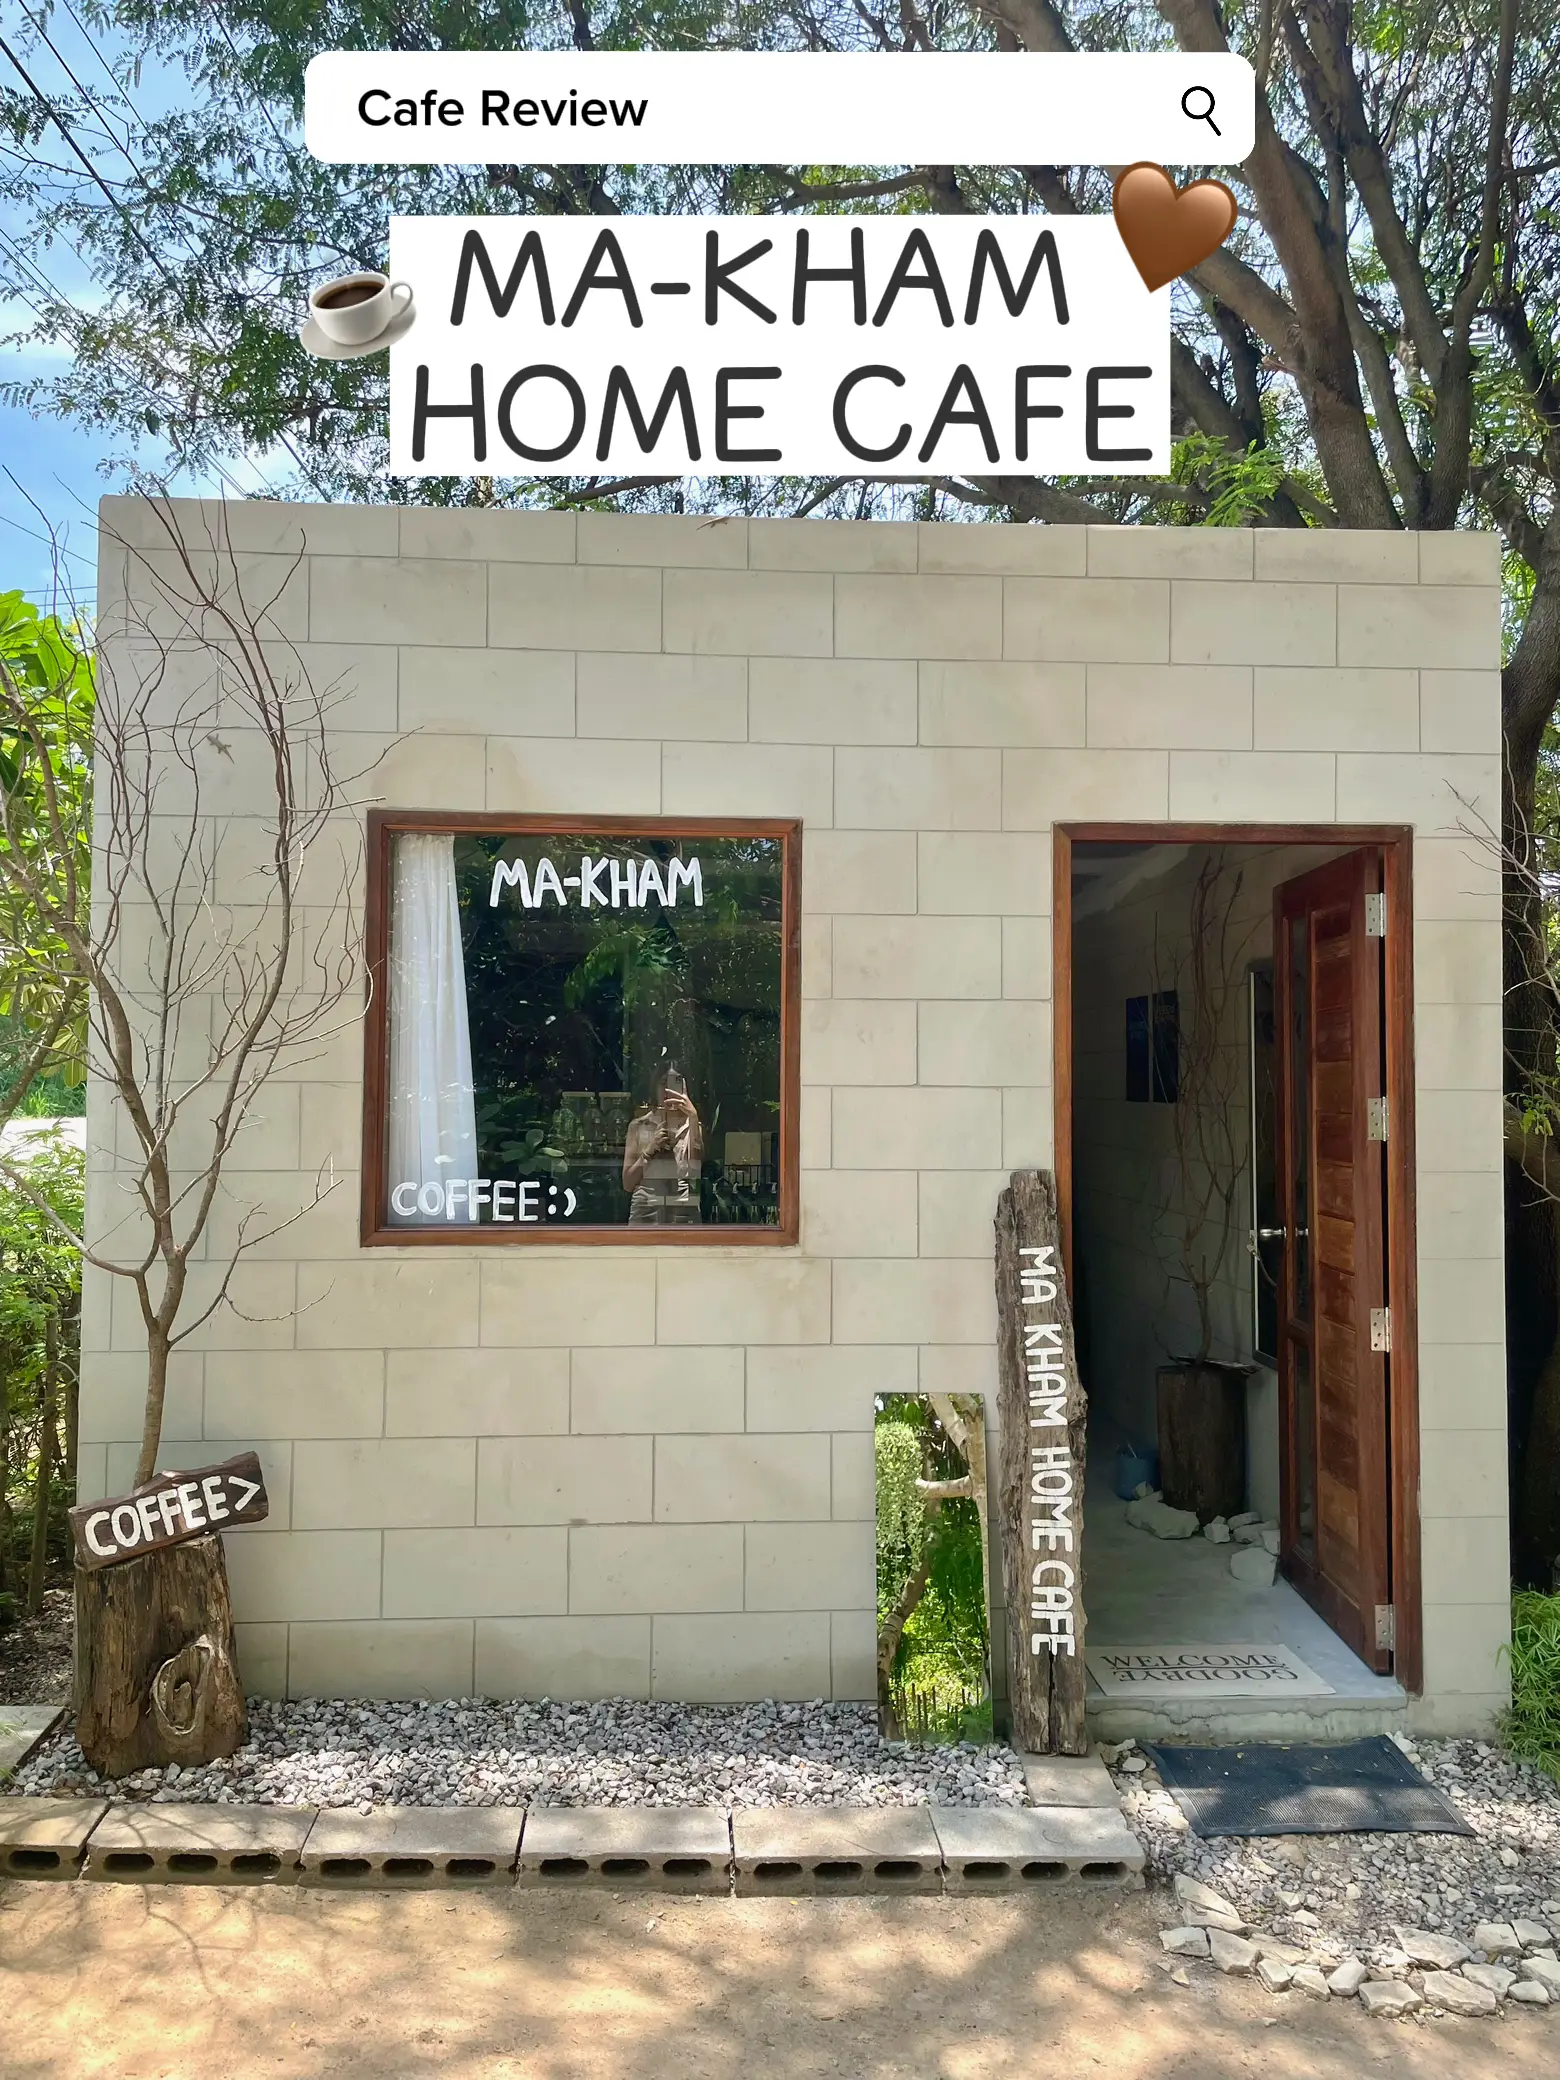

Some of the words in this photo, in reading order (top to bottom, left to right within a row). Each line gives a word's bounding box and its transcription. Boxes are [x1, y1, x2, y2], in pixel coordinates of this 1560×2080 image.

[489, 856, 704, 908] MA-KHAM
[1019, 1245, 1057, 1304] MA
[1023, 1323, 1068, 1428] KHAM
[1031, 1446, 1074, 1553] HOME
[1031, 1560, 1076, 1657] CAFE
[1100, 1654, 1286, 1668] WELCOME
[1112, 1667, 1299, 1682] GOODBYE
